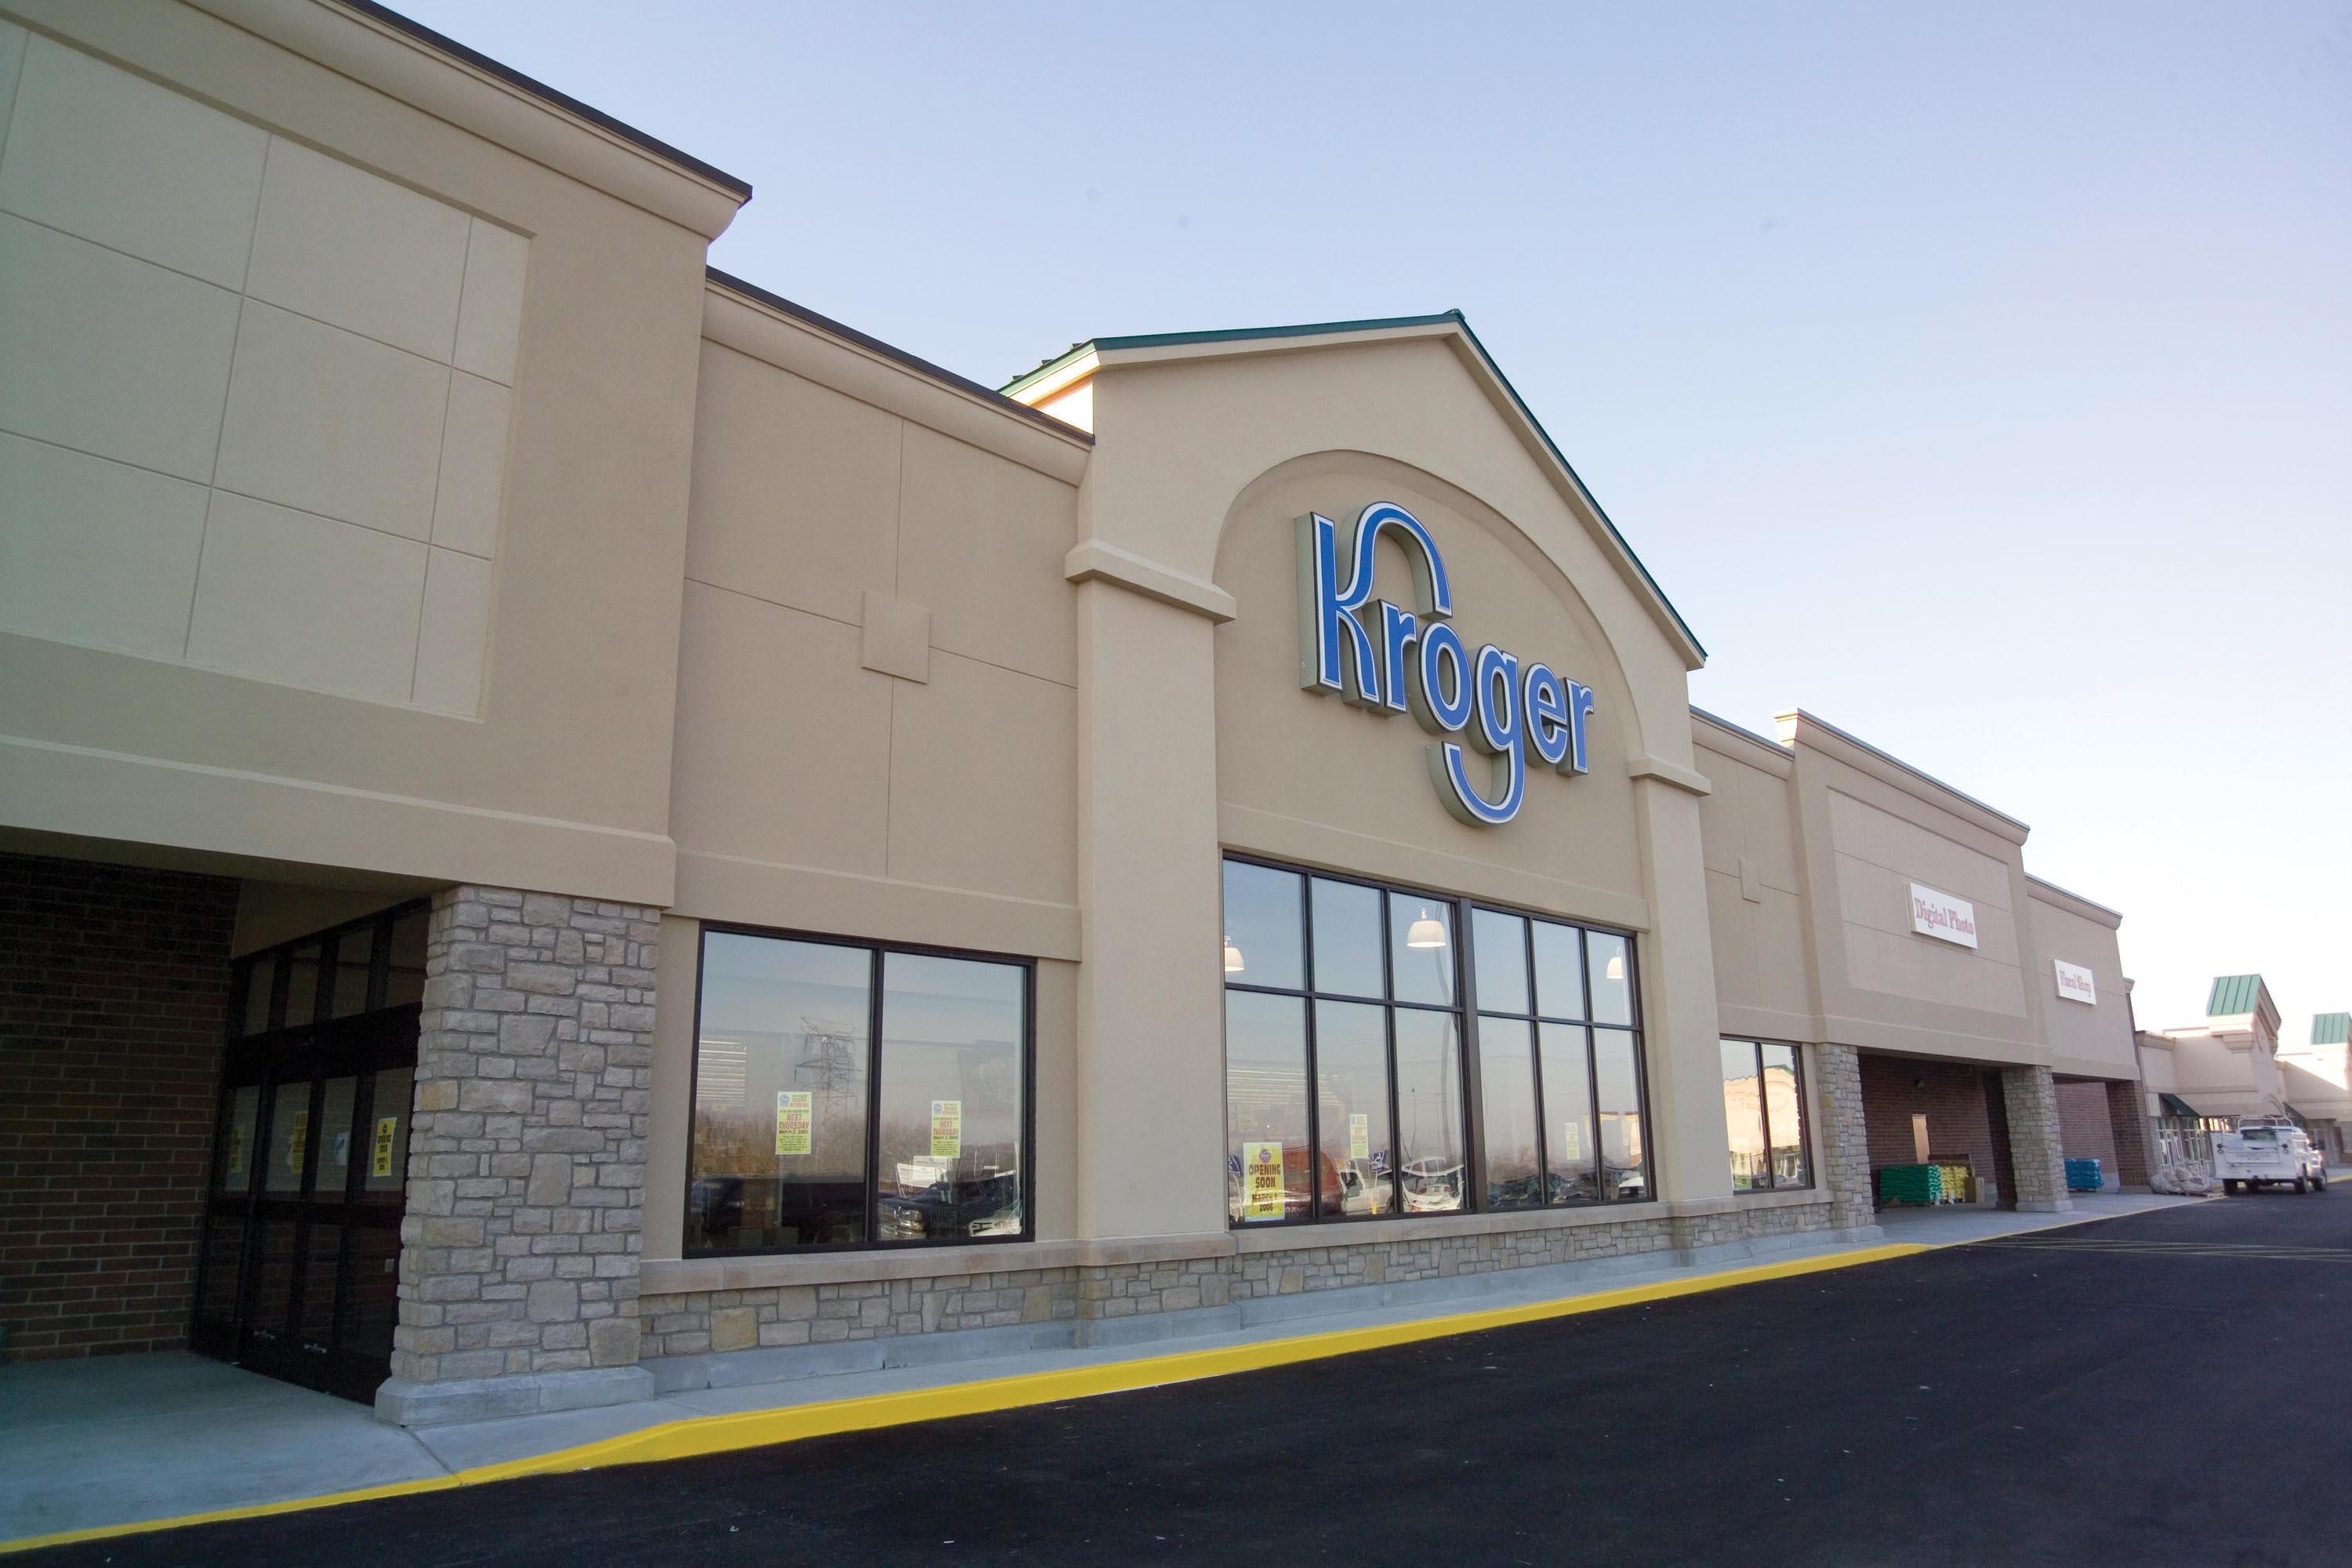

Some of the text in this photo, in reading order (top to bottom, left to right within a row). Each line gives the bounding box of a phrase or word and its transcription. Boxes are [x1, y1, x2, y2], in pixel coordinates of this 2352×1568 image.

[1298, 502, 1595, 826] Kroger
[1914, 898, 1974, 935] Digital Photo
[779, 1121, 809, 1130] THURSDAY
[1248, 1163, 1281, 1176] OPENING
[1255, 1176, 1276, 1189] SOON
[1259, 1203, 1273, 1212] 2006
